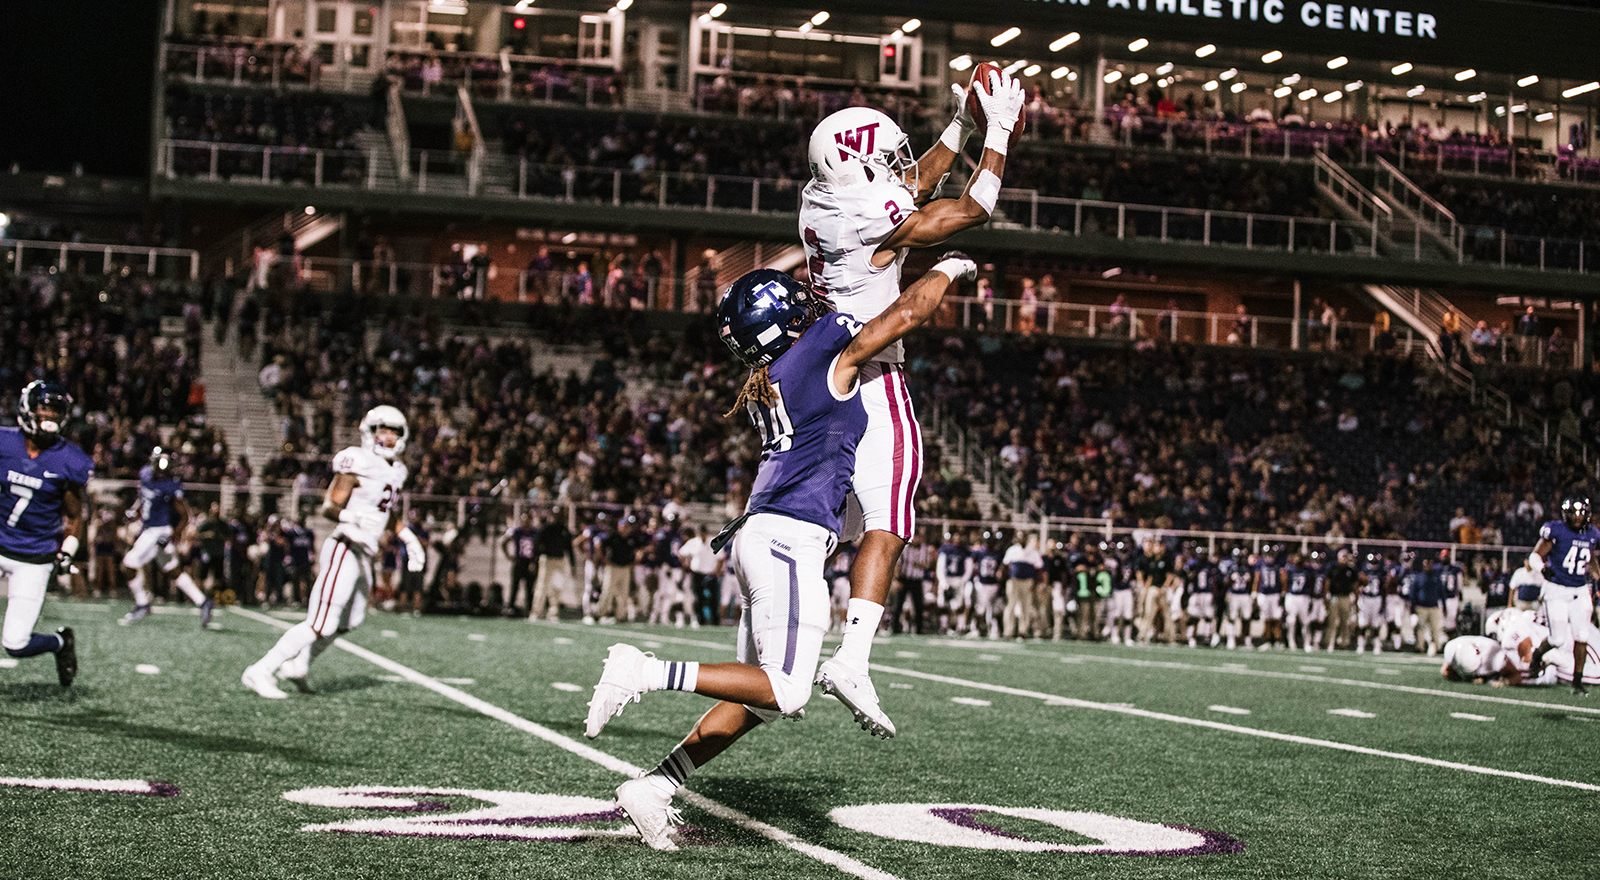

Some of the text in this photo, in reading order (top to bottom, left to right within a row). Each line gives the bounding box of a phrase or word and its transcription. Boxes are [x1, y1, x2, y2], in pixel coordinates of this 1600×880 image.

[1300, 1, 1437, 39] CENTER
[834, 122, 880, 162] WT
[884, 200, 904, 226] 2
[7, 484, 33, 528] 7
[1562, 545, 1591, 576] 42
[1076, 571, 1112, 597] 13
